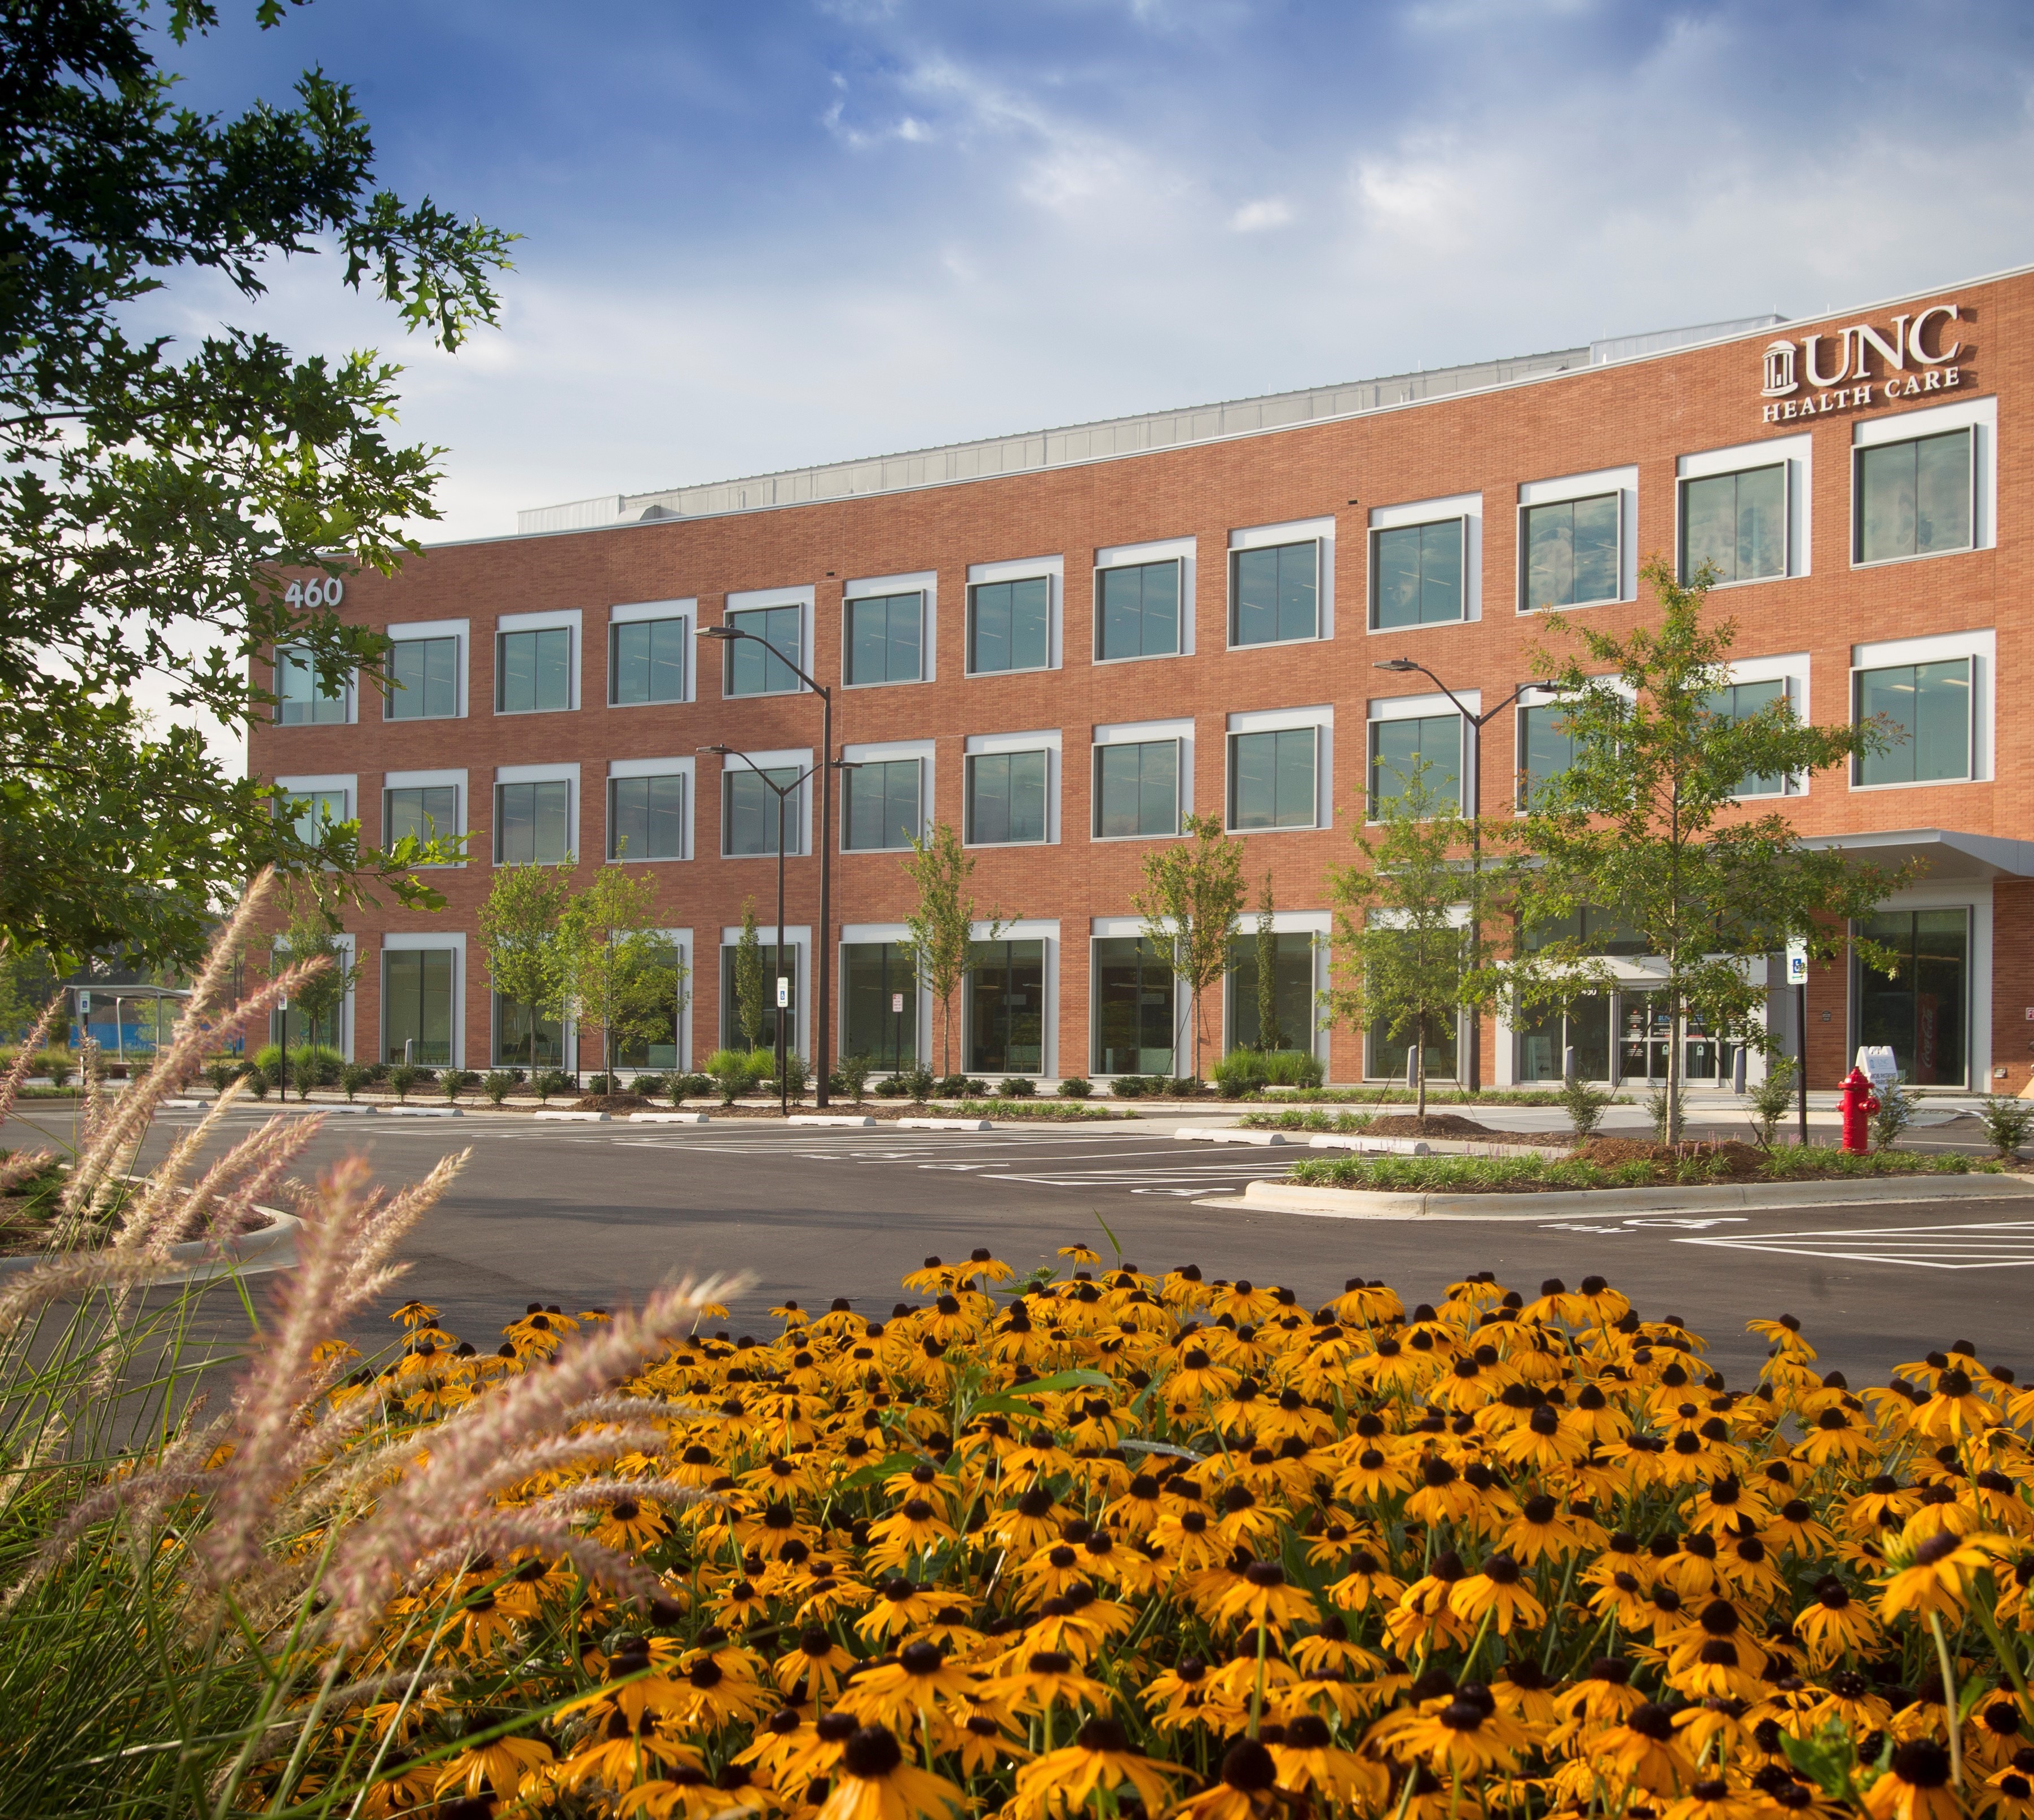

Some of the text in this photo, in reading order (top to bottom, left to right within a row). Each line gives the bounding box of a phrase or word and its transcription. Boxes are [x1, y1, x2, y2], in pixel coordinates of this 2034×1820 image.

[1801, 304, 1960, 387] UNC
[1762, 366, 1960, 423] HEALTH CARE
[285, 577, 342, 608] 460
